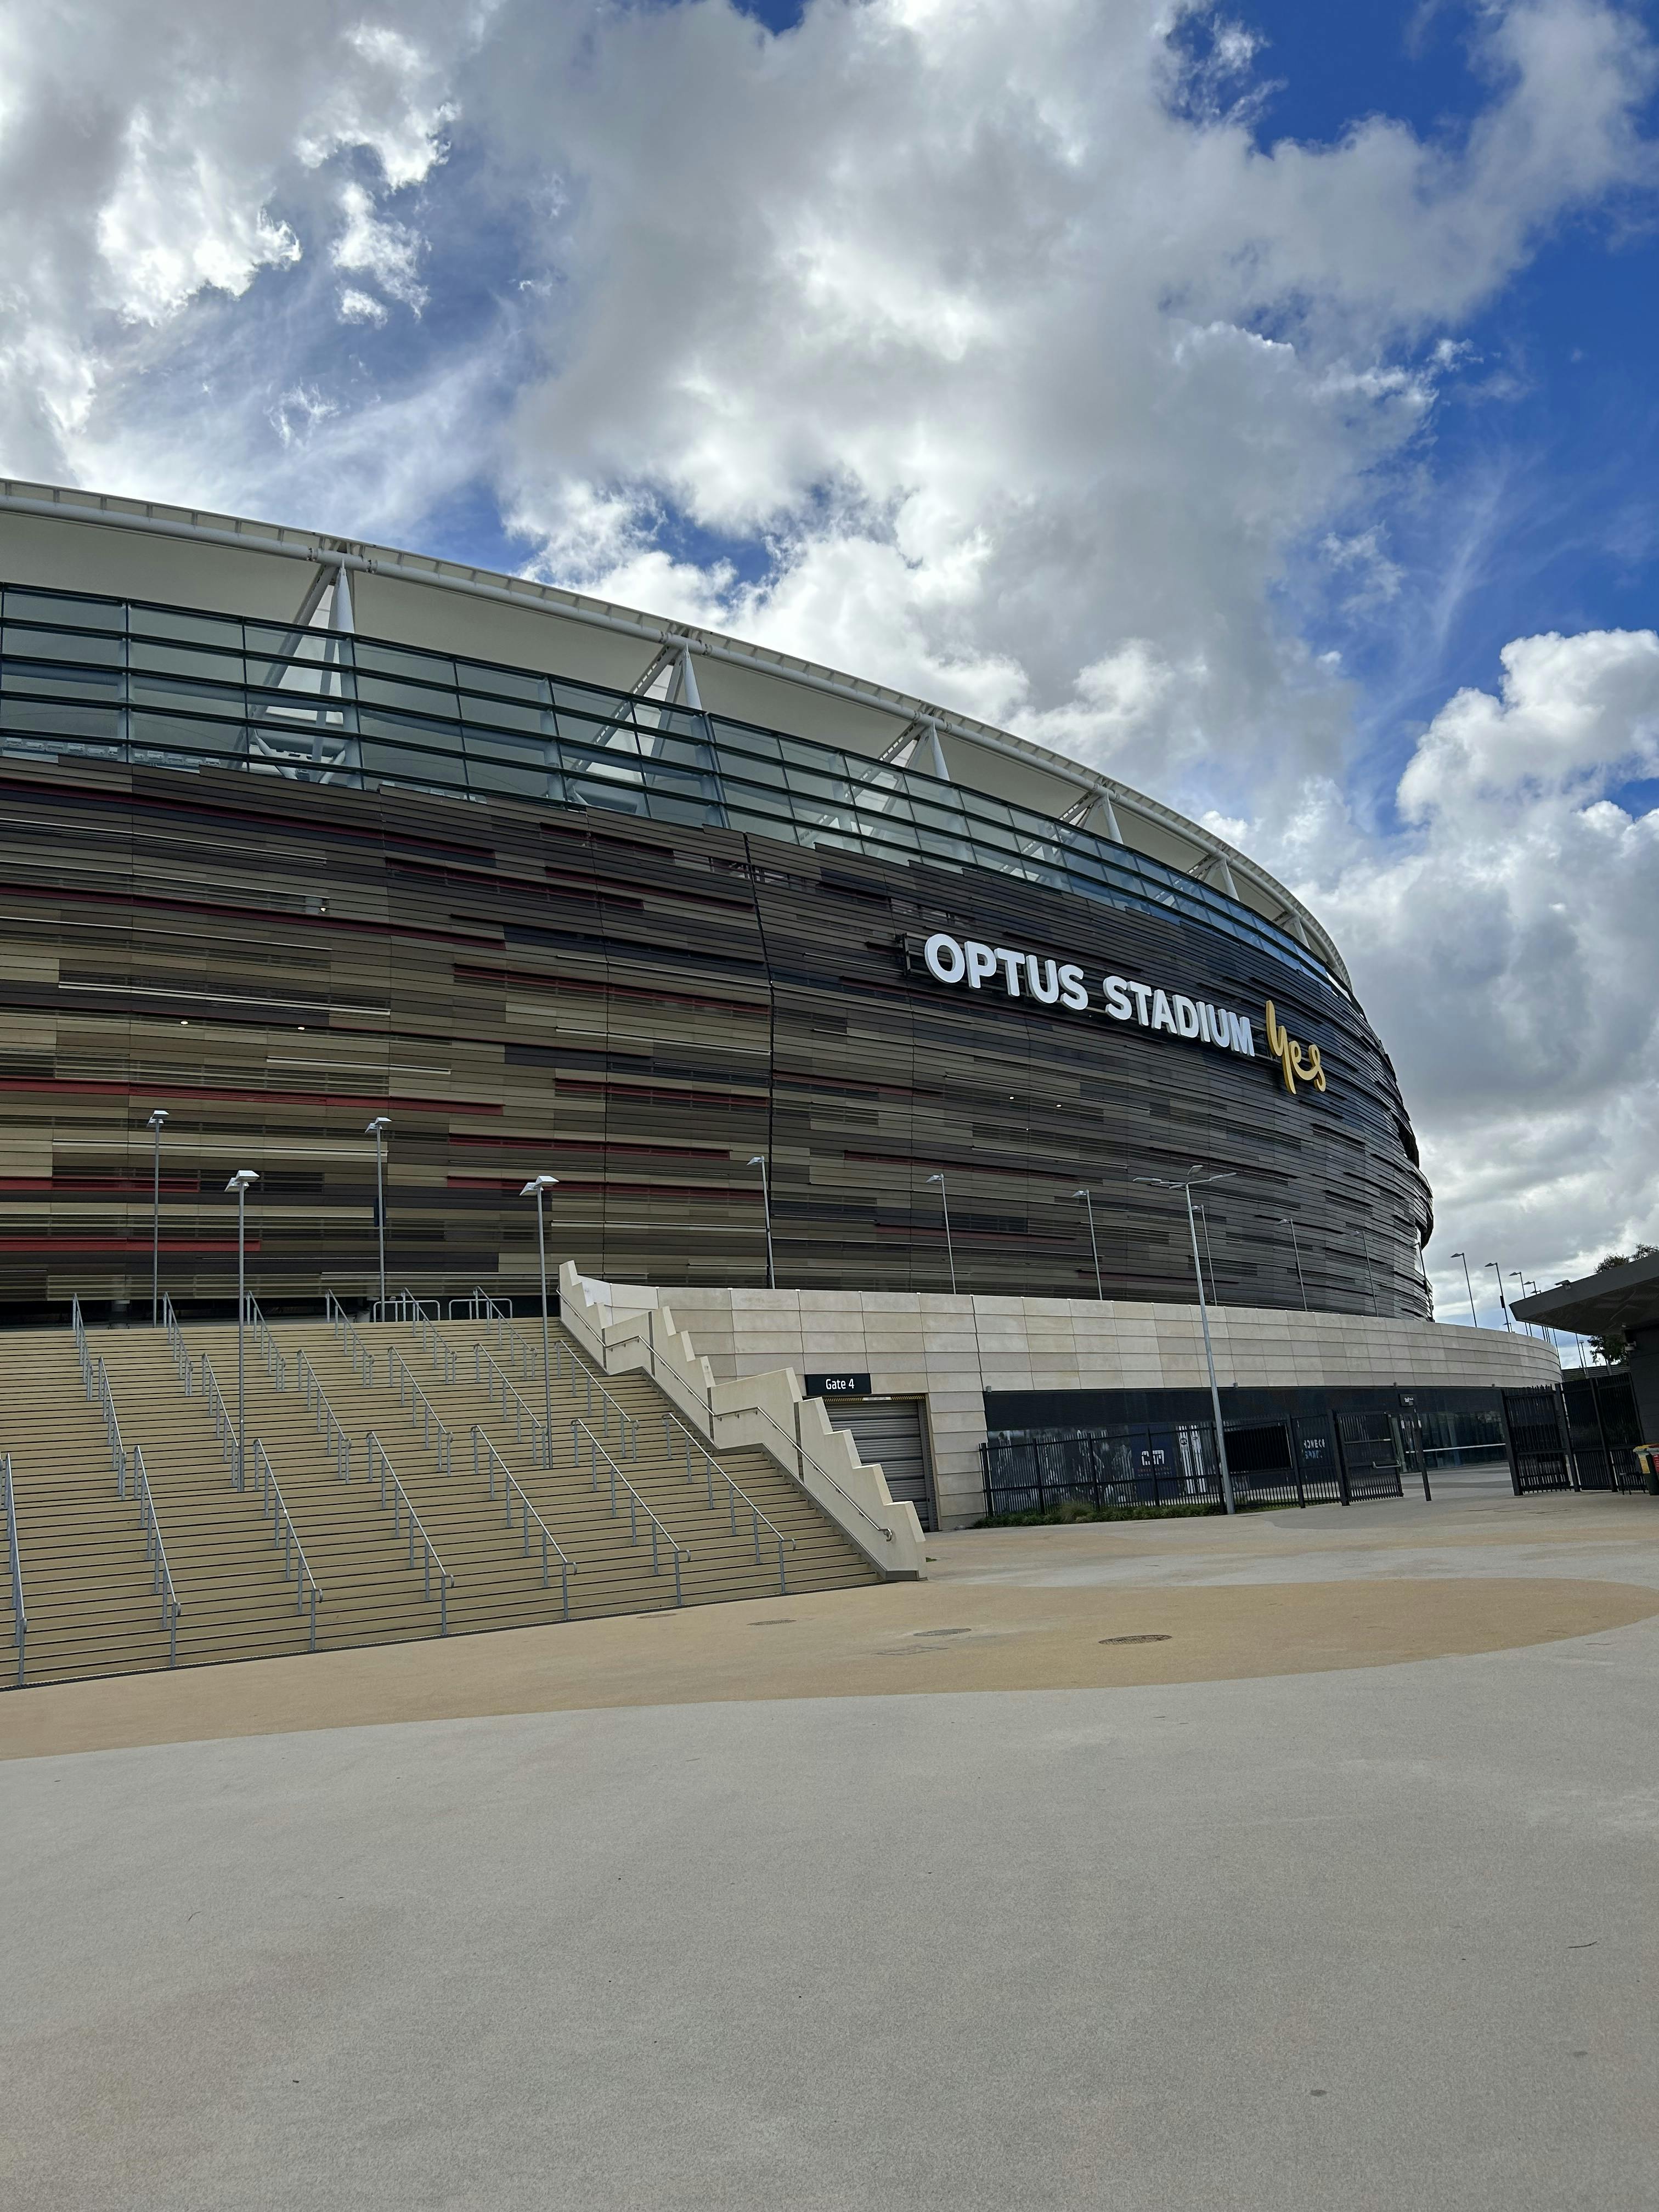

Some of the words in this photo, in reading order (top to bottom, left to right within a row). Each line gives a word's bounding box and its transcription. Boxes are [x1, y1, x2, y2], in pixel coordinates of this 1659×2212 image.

[924, 933, 1088, 1011] OPTUS
[1103, 975, 1255, 1057] STADIUM
[826, 1379, 846, 1390] Gate
[848, 1378, 855, 1389] 4
